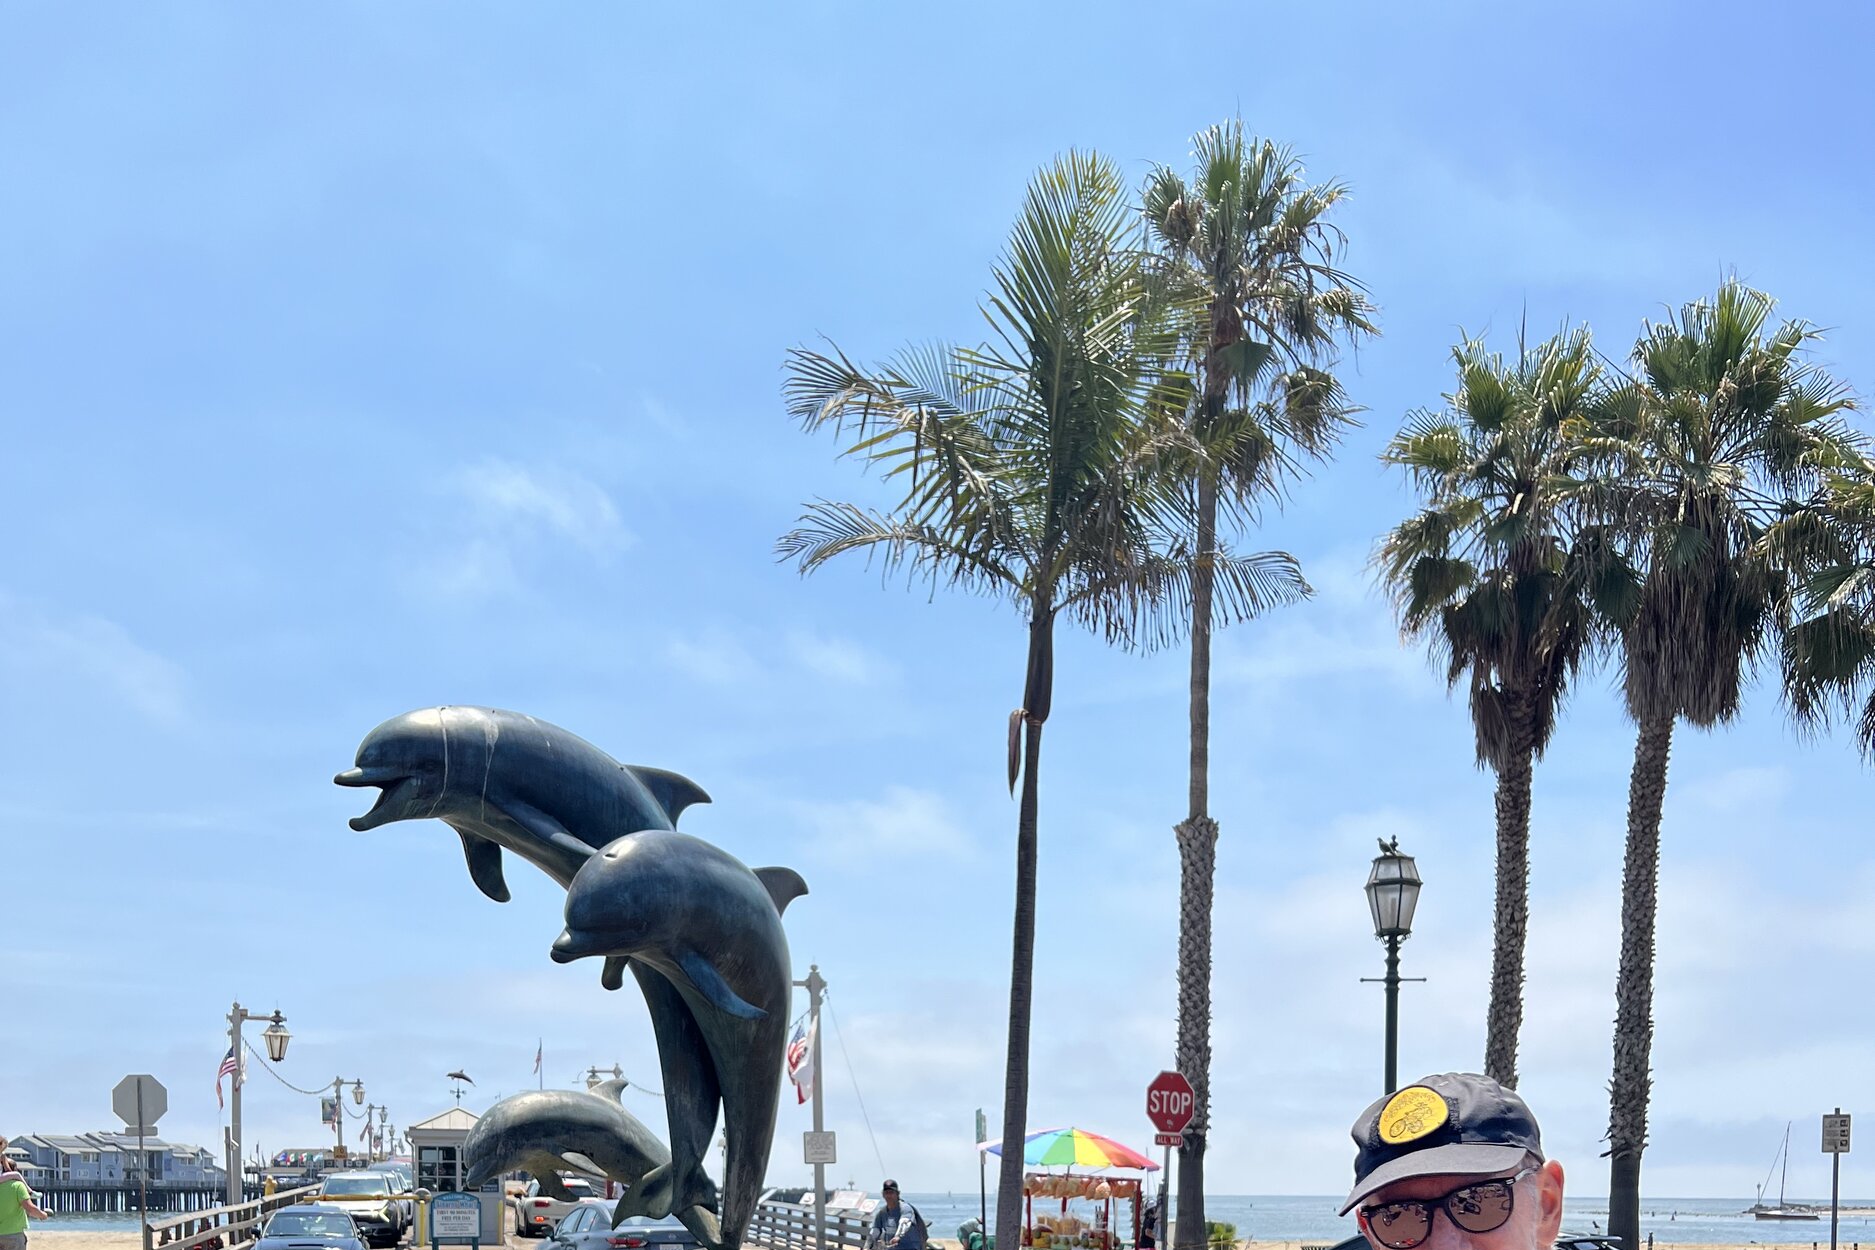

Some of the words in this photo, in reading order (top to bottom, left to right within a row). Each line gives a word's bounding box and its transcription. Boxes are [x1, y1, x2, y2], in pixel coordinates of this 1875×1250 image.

[1150, 1090, 1191, 1115] STOP
[1157, 1136, 1168, 1144] ALL
[1170, 1136, 1181, 1144] WAY
